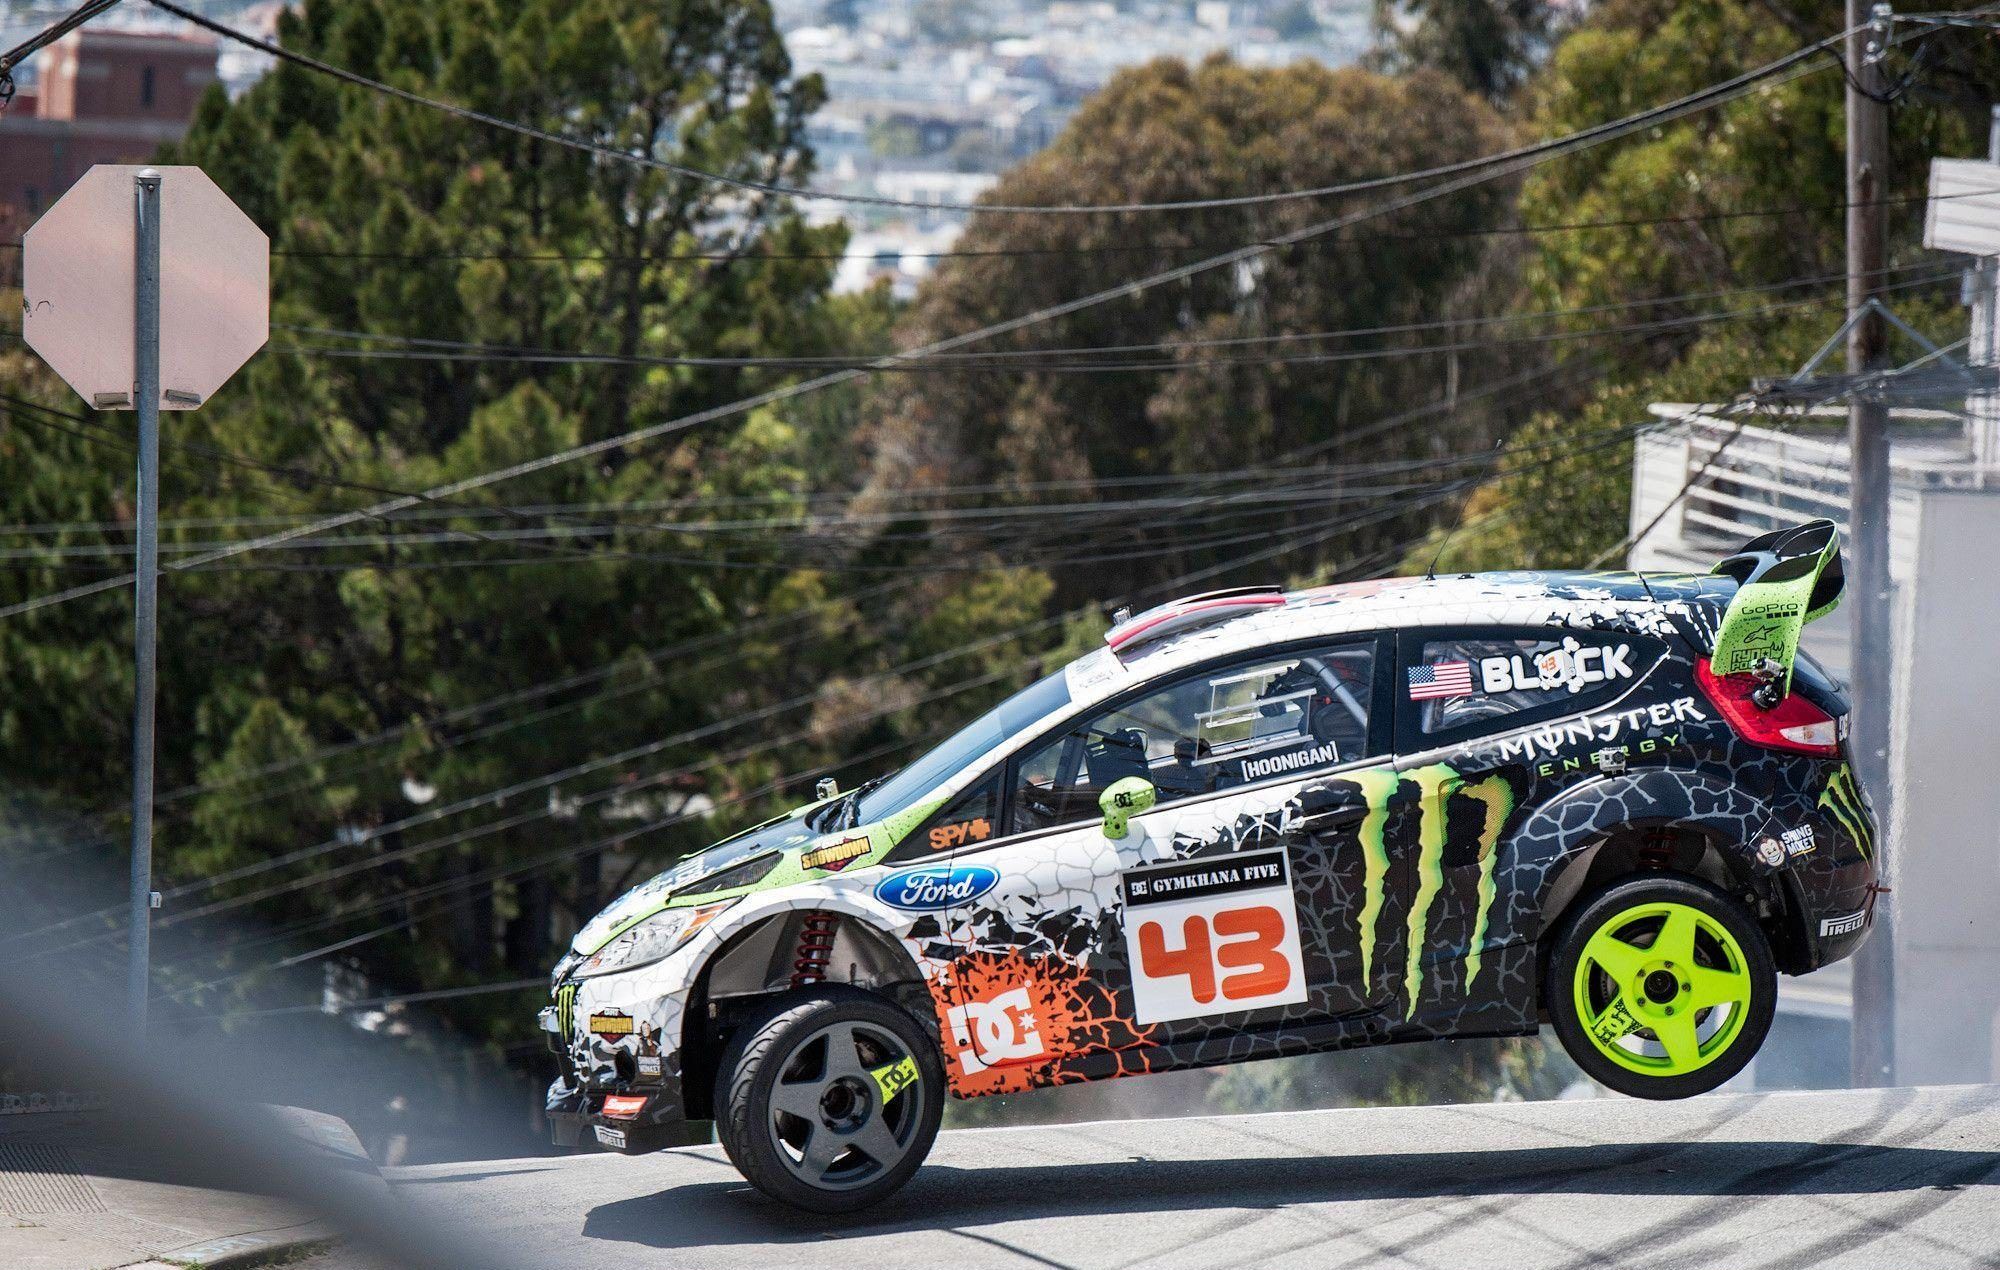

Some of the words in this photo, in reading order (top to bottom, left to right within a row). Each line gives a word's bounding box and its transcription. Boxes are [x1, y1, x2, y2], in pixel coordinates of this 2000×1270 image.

[1742, 603, 1798, 615] GoPro
[1541, 656, 1557, 672] 43
[1499, 697, 1706, 761] MONSTER
[1242, 741, 1339, 782] [HOONIGAN]
[930, 821, 969, 850] SPY
[901, 871, 975, 905] Ford
[1154, 868, 1241, 893] GYMKHANA
[1244, 863, 1279, 880] FIVE
[1820, 909, 1866, 937] PIRELLI
[1138, 905, 1291, 1004] 43
[946, 986, 1045, 1075] DC
